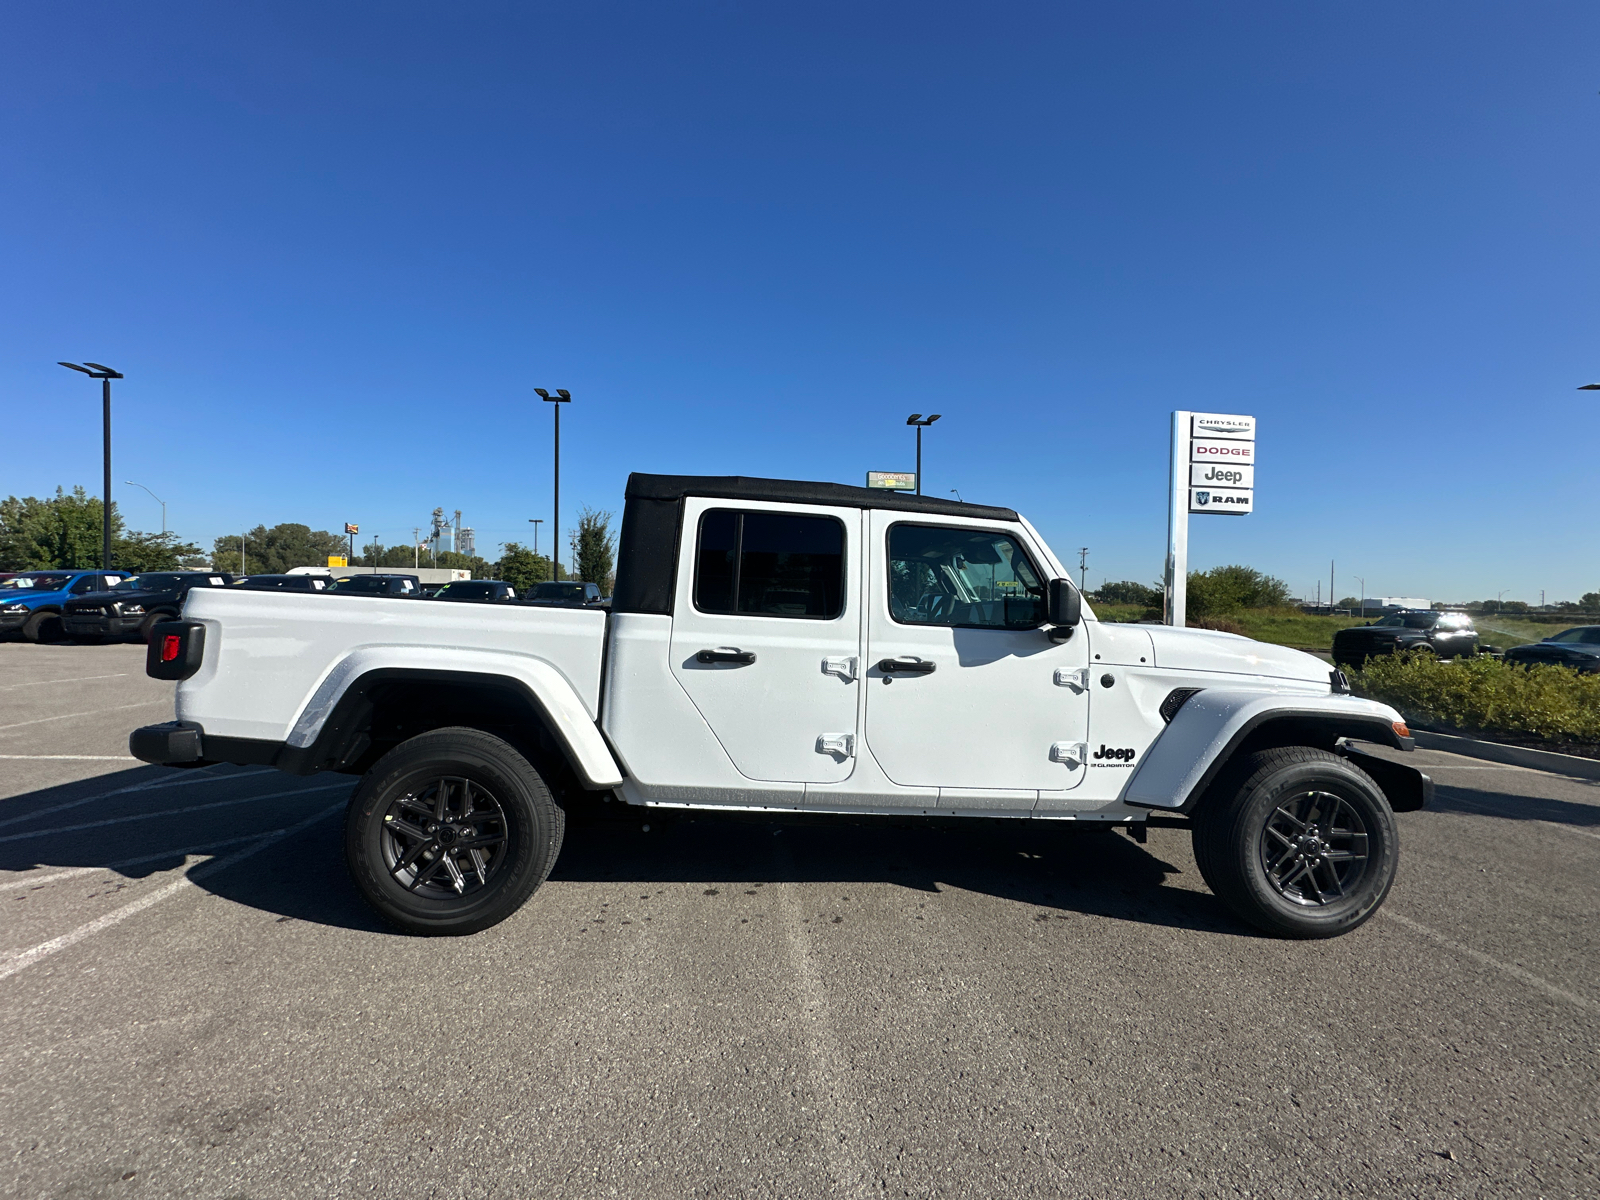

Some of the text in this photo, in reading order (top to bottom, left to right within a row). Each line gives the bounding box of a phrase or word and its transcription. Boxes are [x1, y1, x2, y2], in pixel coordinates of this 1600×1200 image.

[1199, 419, 1250, 427] CHRYSLER
[1197, 446, 1250, 456] DODGE
[1204, 466, 1242, 484] Jeep
[1212, 496, 1249, 504] RAM
[1093, 744, 1135, 762] Jeep
